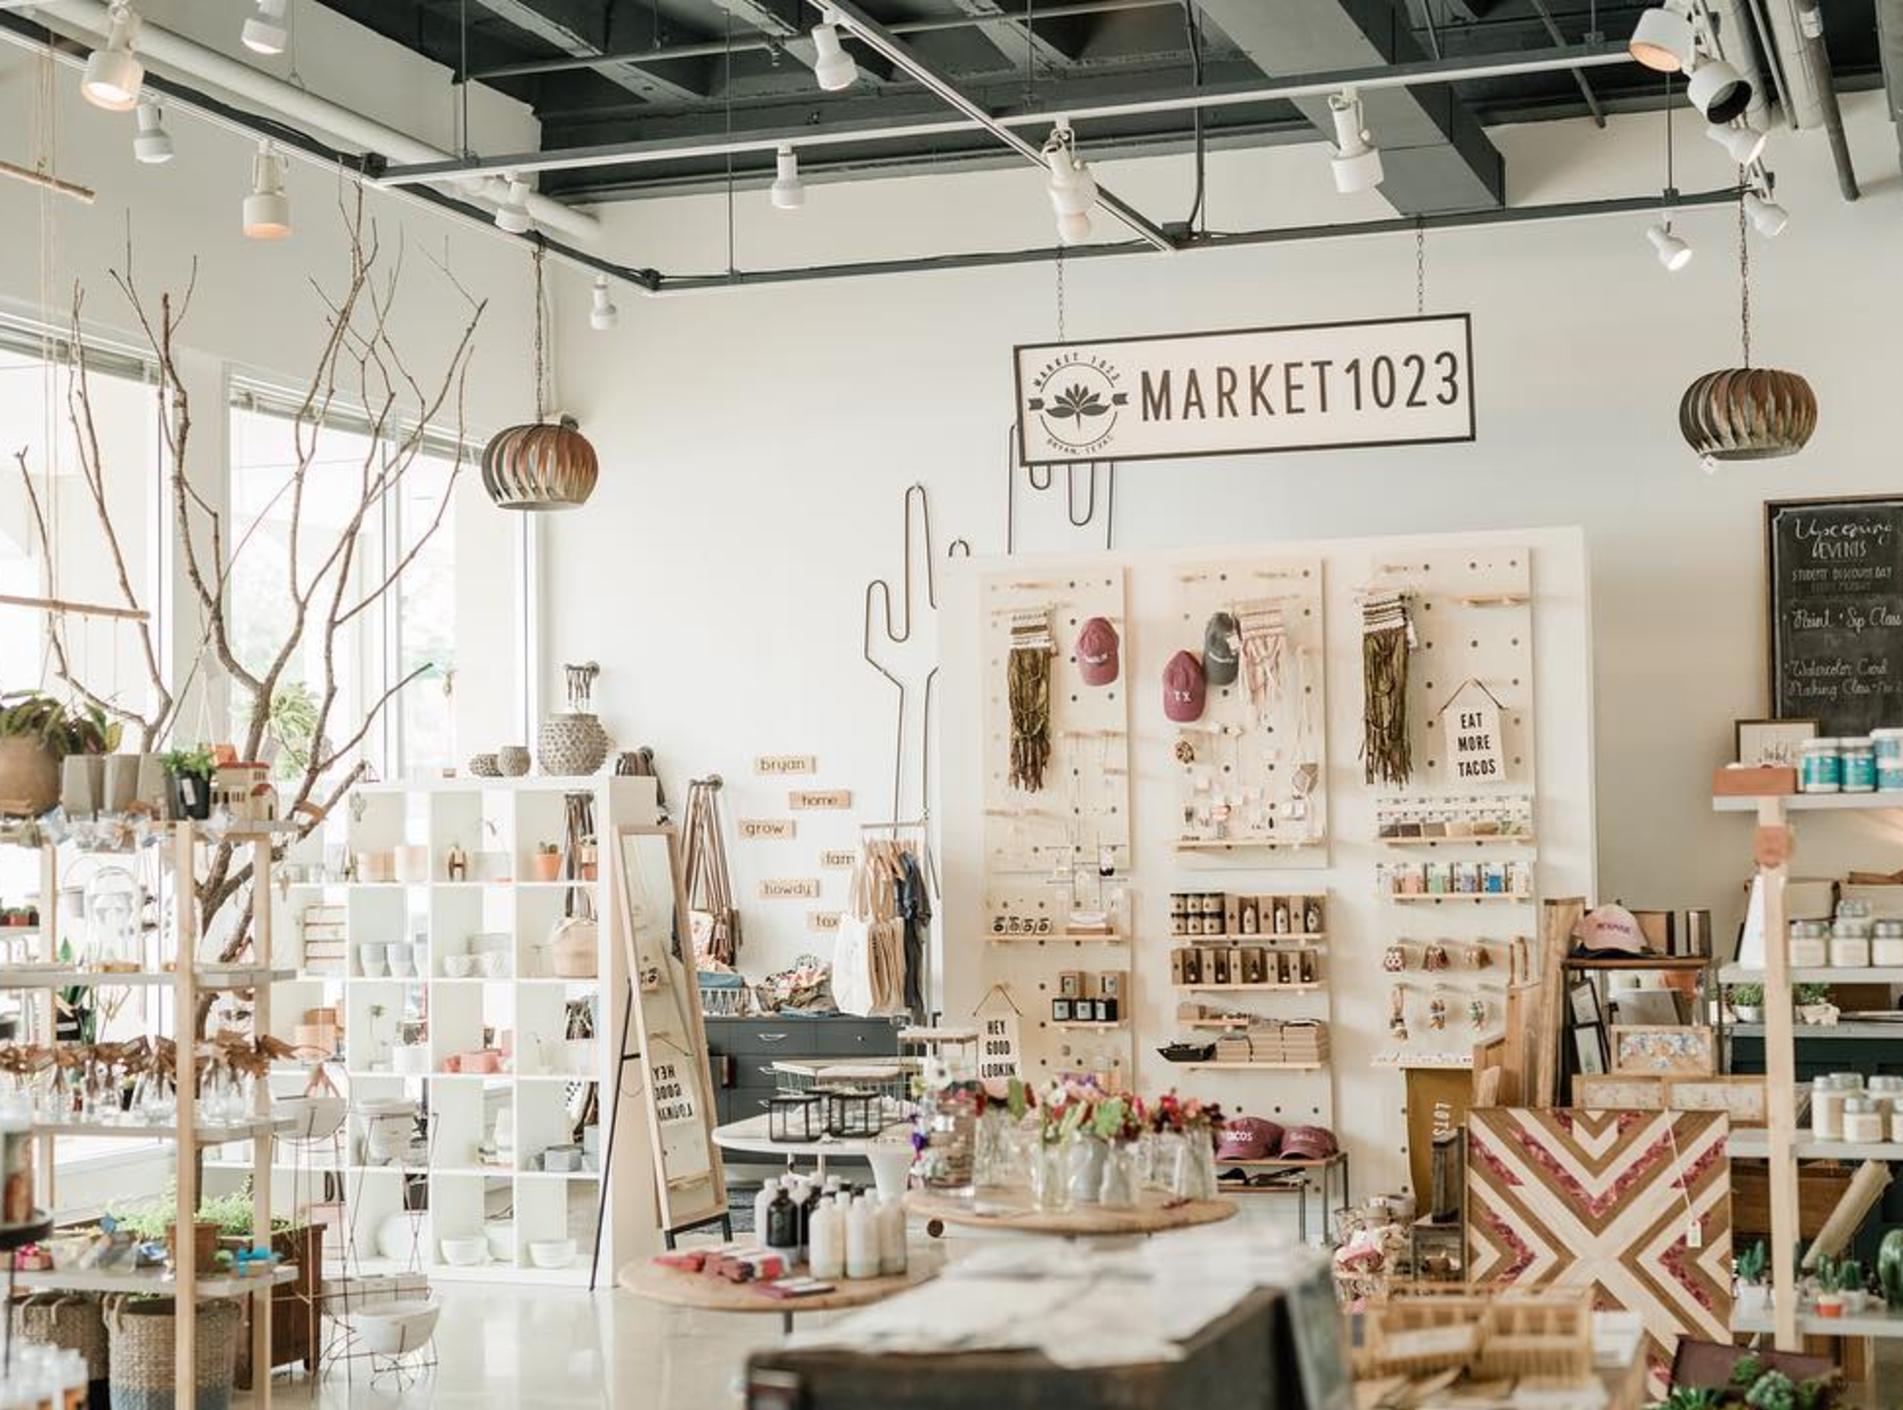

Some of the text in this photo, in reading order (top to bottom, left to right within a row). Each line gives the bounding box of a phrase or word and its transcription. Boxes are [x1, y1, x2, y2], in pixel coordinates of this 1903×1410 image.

[1460, 712, 1482, 729] EAT
[1458, 734, 1491, 752] MORE
[760, 757, 805, 773] bryan
[1457, 758, 1496, 777] TACOS
[802, 794, 838, 807] home
[745, 822, 784, 836] grow
[764, 882, 811, 896] howdy
[987, 1020, 1006, 1035] HEY
[986, 1040, 1011, 1055] GOOD
